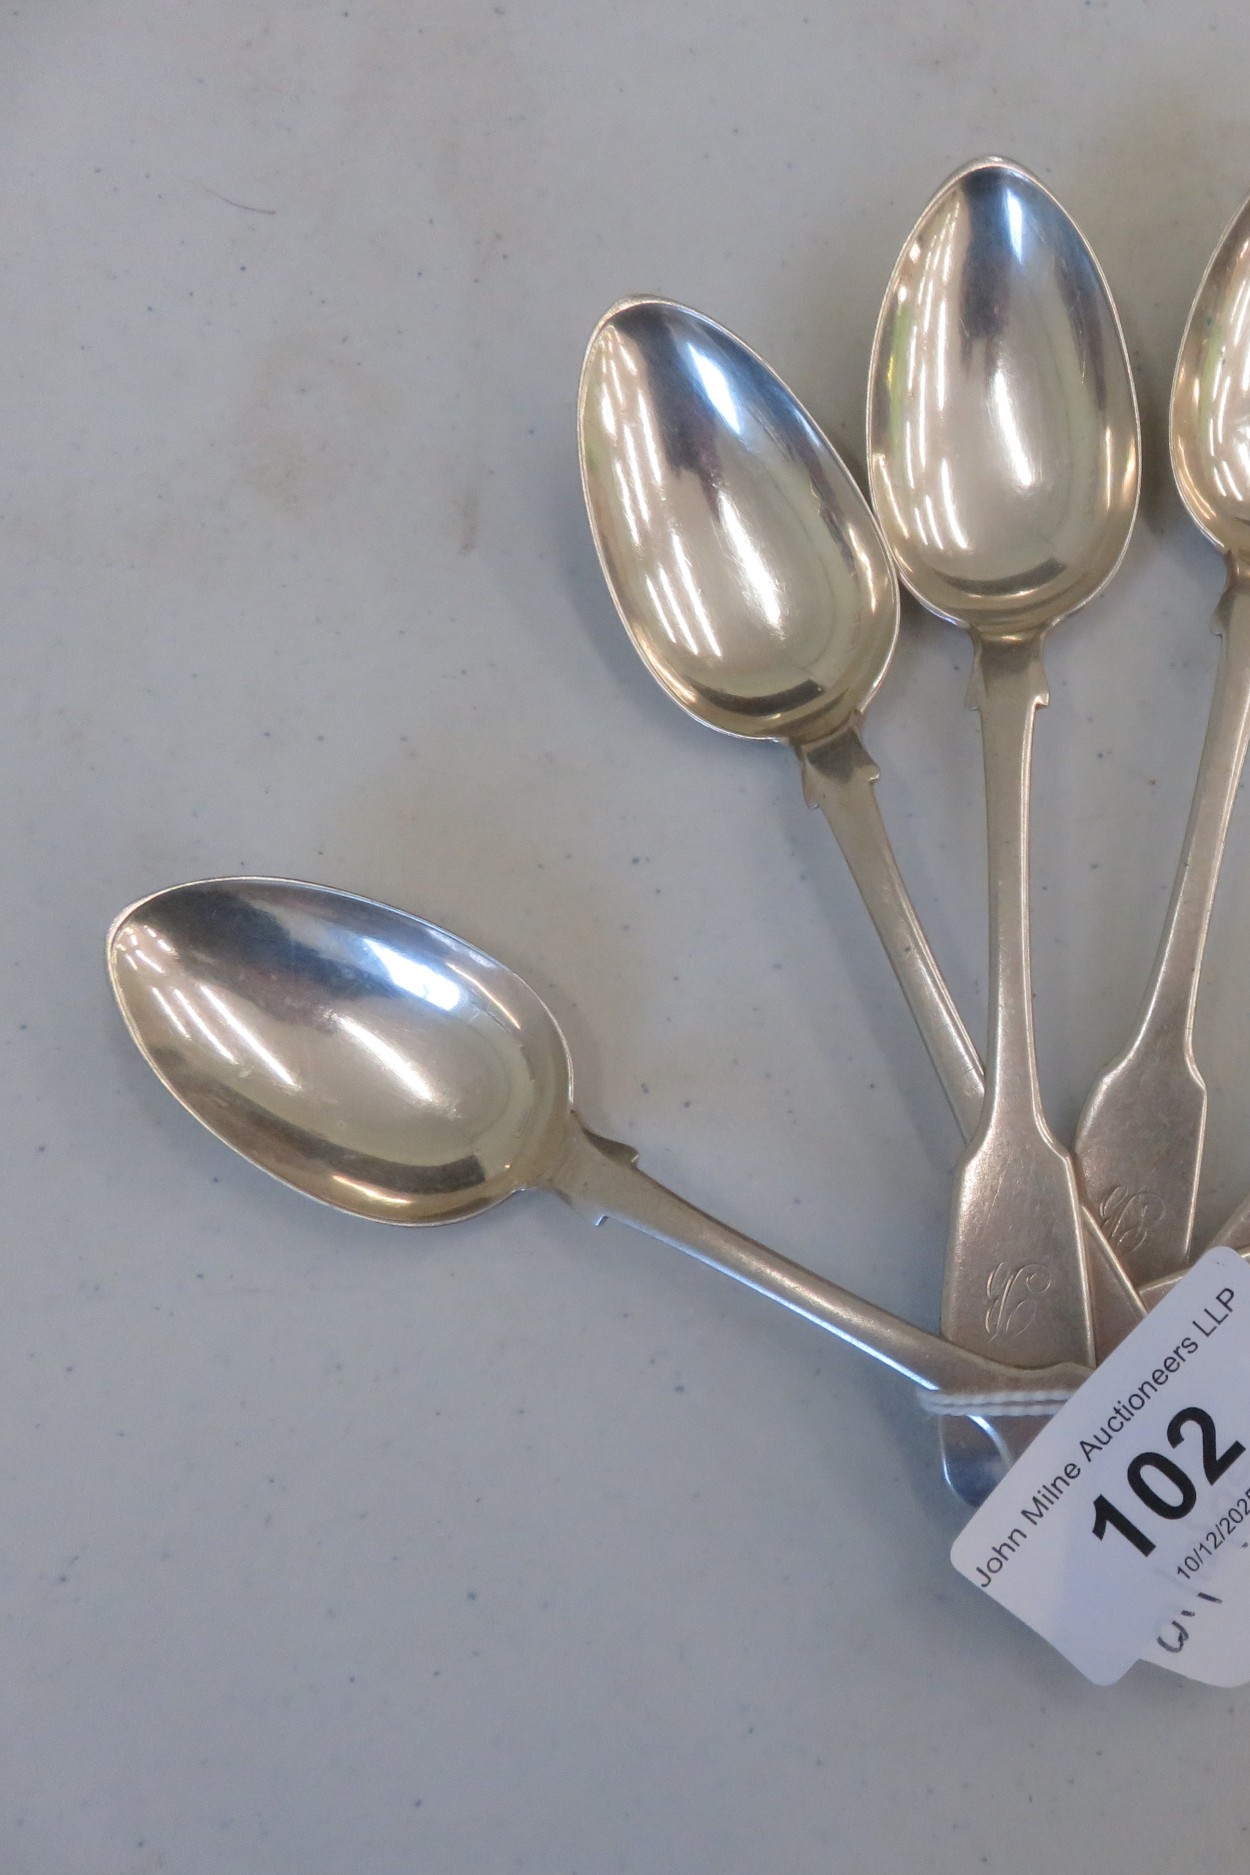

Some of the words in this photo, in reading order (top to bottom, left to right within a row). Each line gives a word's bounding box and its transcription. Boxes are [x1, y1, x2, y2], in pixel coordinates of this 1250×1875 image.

[976, 1529, 1028, 1588] John
[1021, 1464, 1082, 1526] Milne
[1079, 1337, 1199, 1462] Auctioneers
[1195, 1287, 1236, 1338] LLP
[1091, 1406, 1246, 1557] 102
